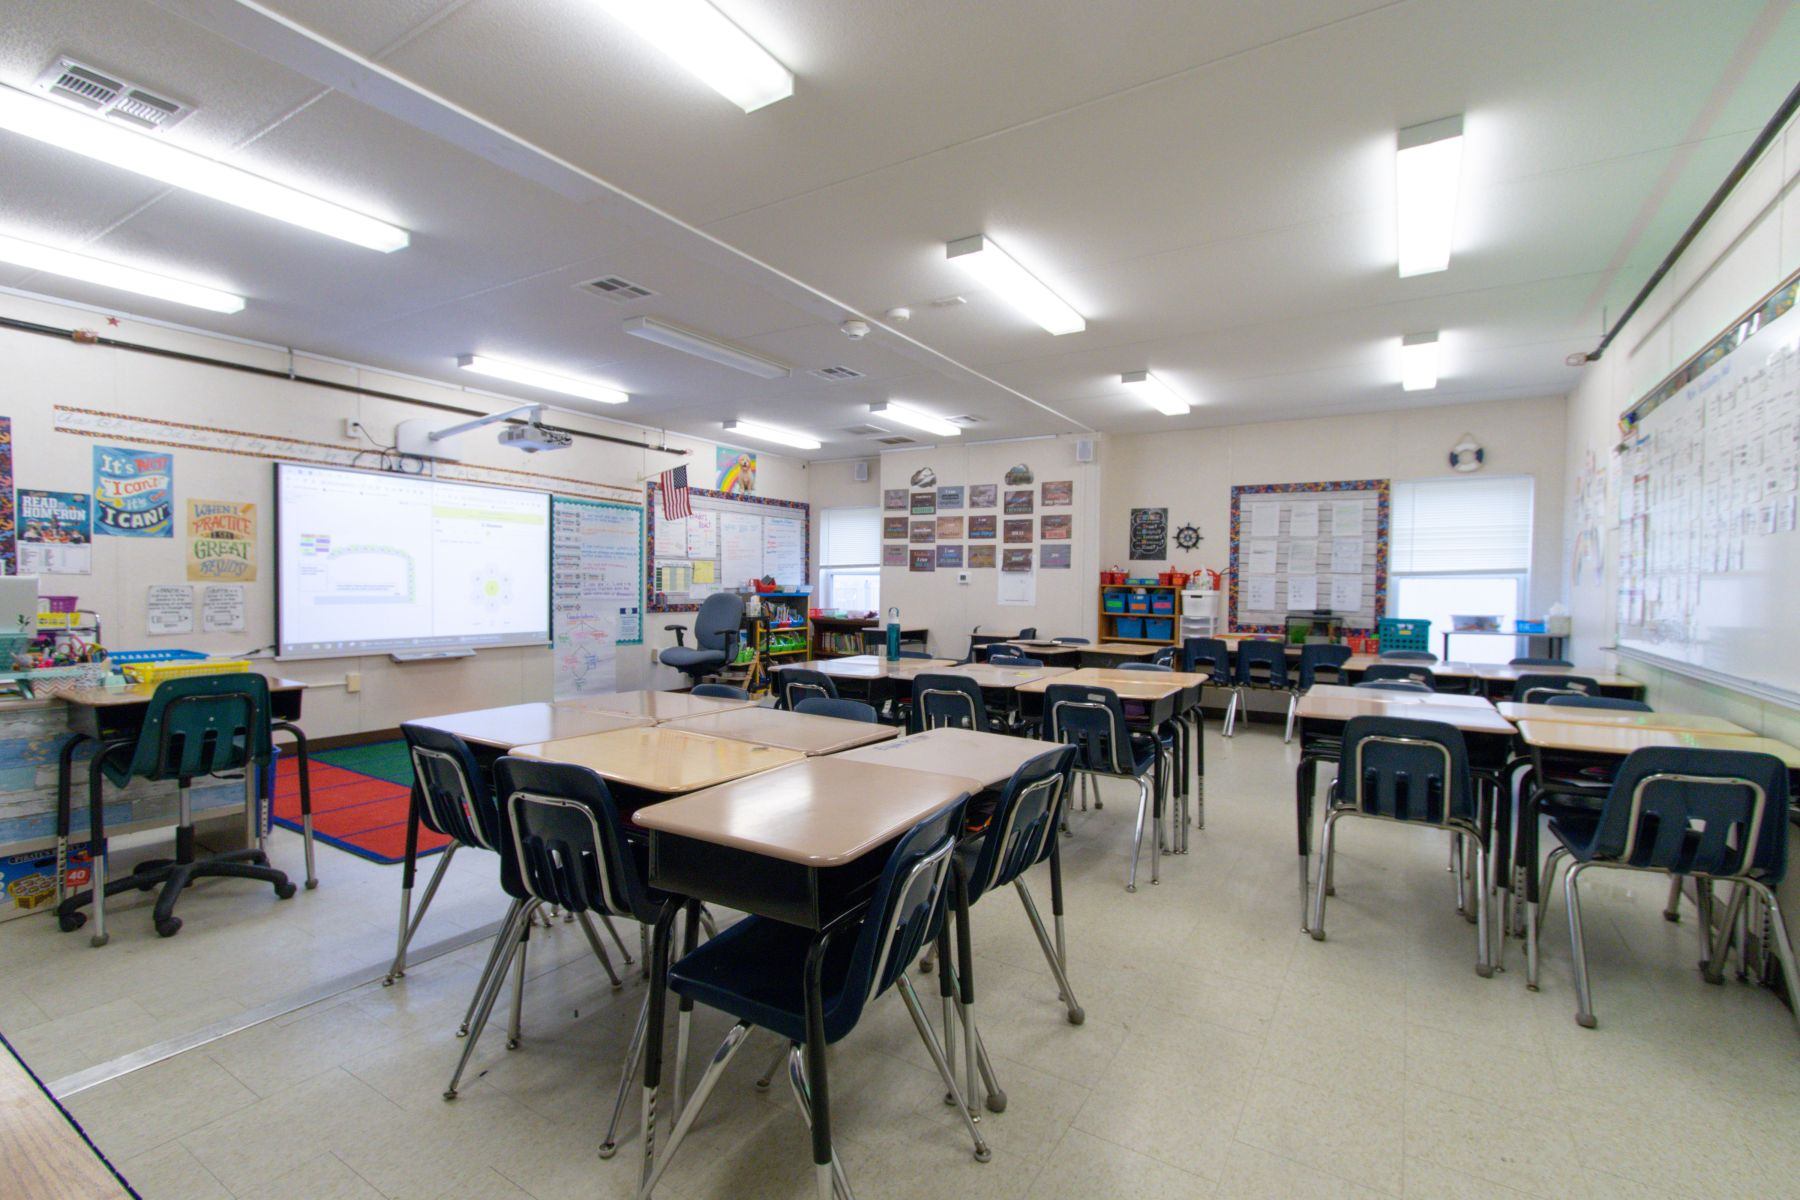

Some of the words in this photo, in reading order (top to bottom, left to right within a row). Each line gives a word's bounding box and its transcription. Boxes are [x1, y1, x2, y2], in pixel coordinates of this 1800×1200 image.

[101, 454, 134, 474] It's
[22, 495, 58, 510] READ
[192, 514, 252, 535] PRACTICE
[193, 541, 251, 560] GREAT
[69, 870, 86, 880] 40
